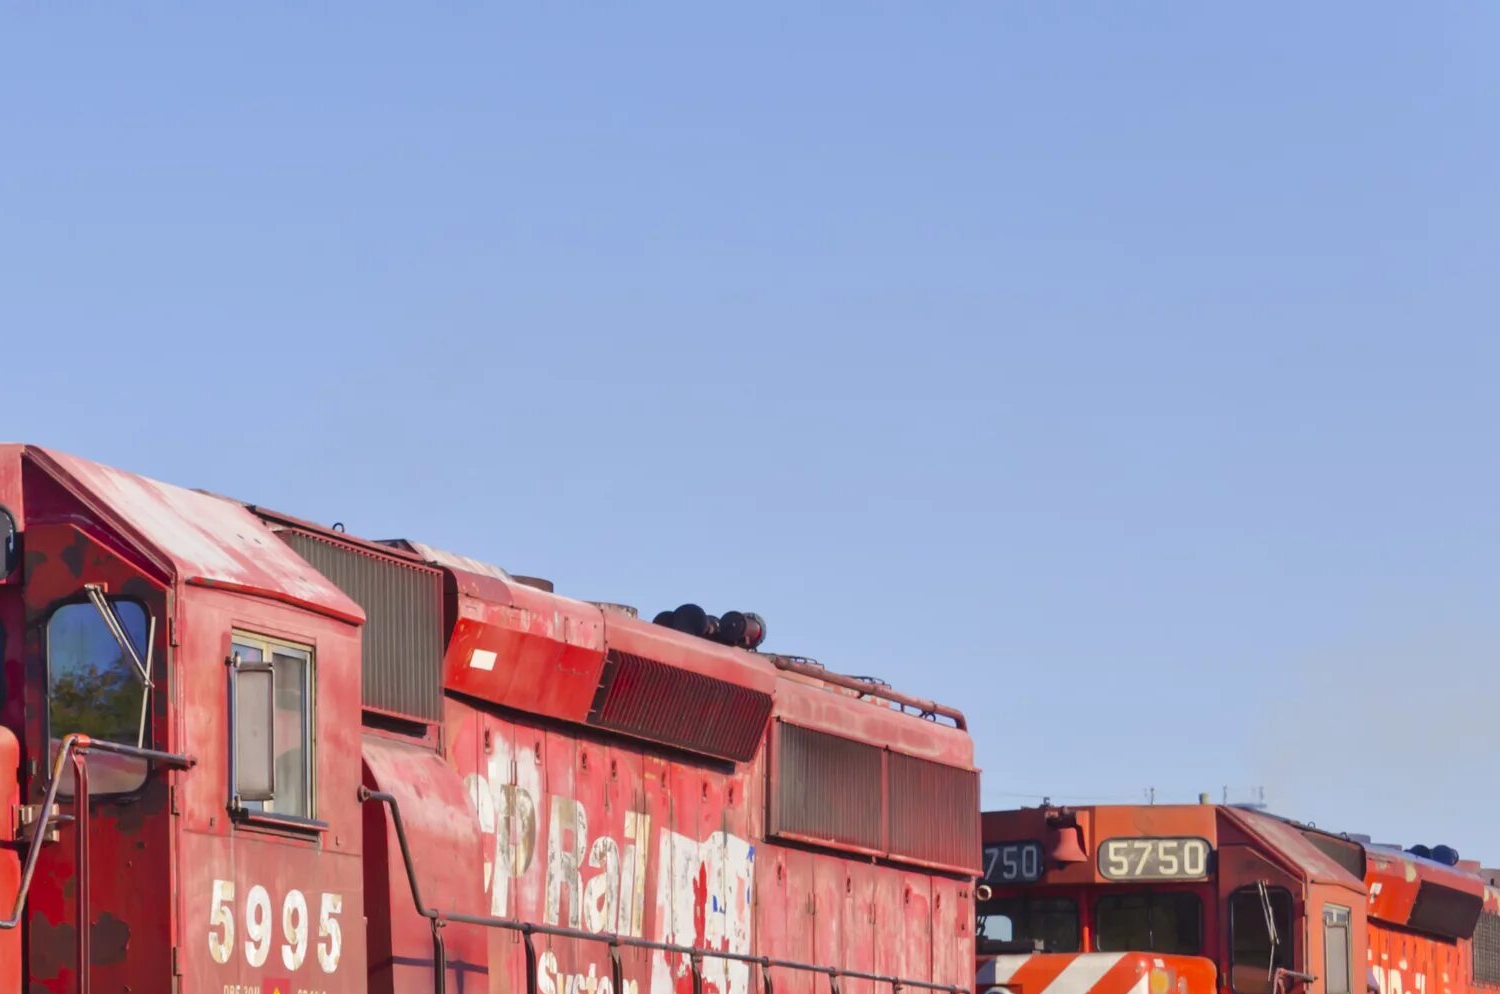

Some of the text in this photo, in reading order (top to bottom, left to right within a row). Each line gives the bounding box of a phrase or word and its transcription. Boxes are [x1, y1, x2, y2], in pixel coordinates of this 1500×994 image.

[543, 794, 651, 938] Rail
[984, 846, 1038, 881] 750
[1108, 840, 1205, 876] 5750
[208, 879, 343, 974] 5995
